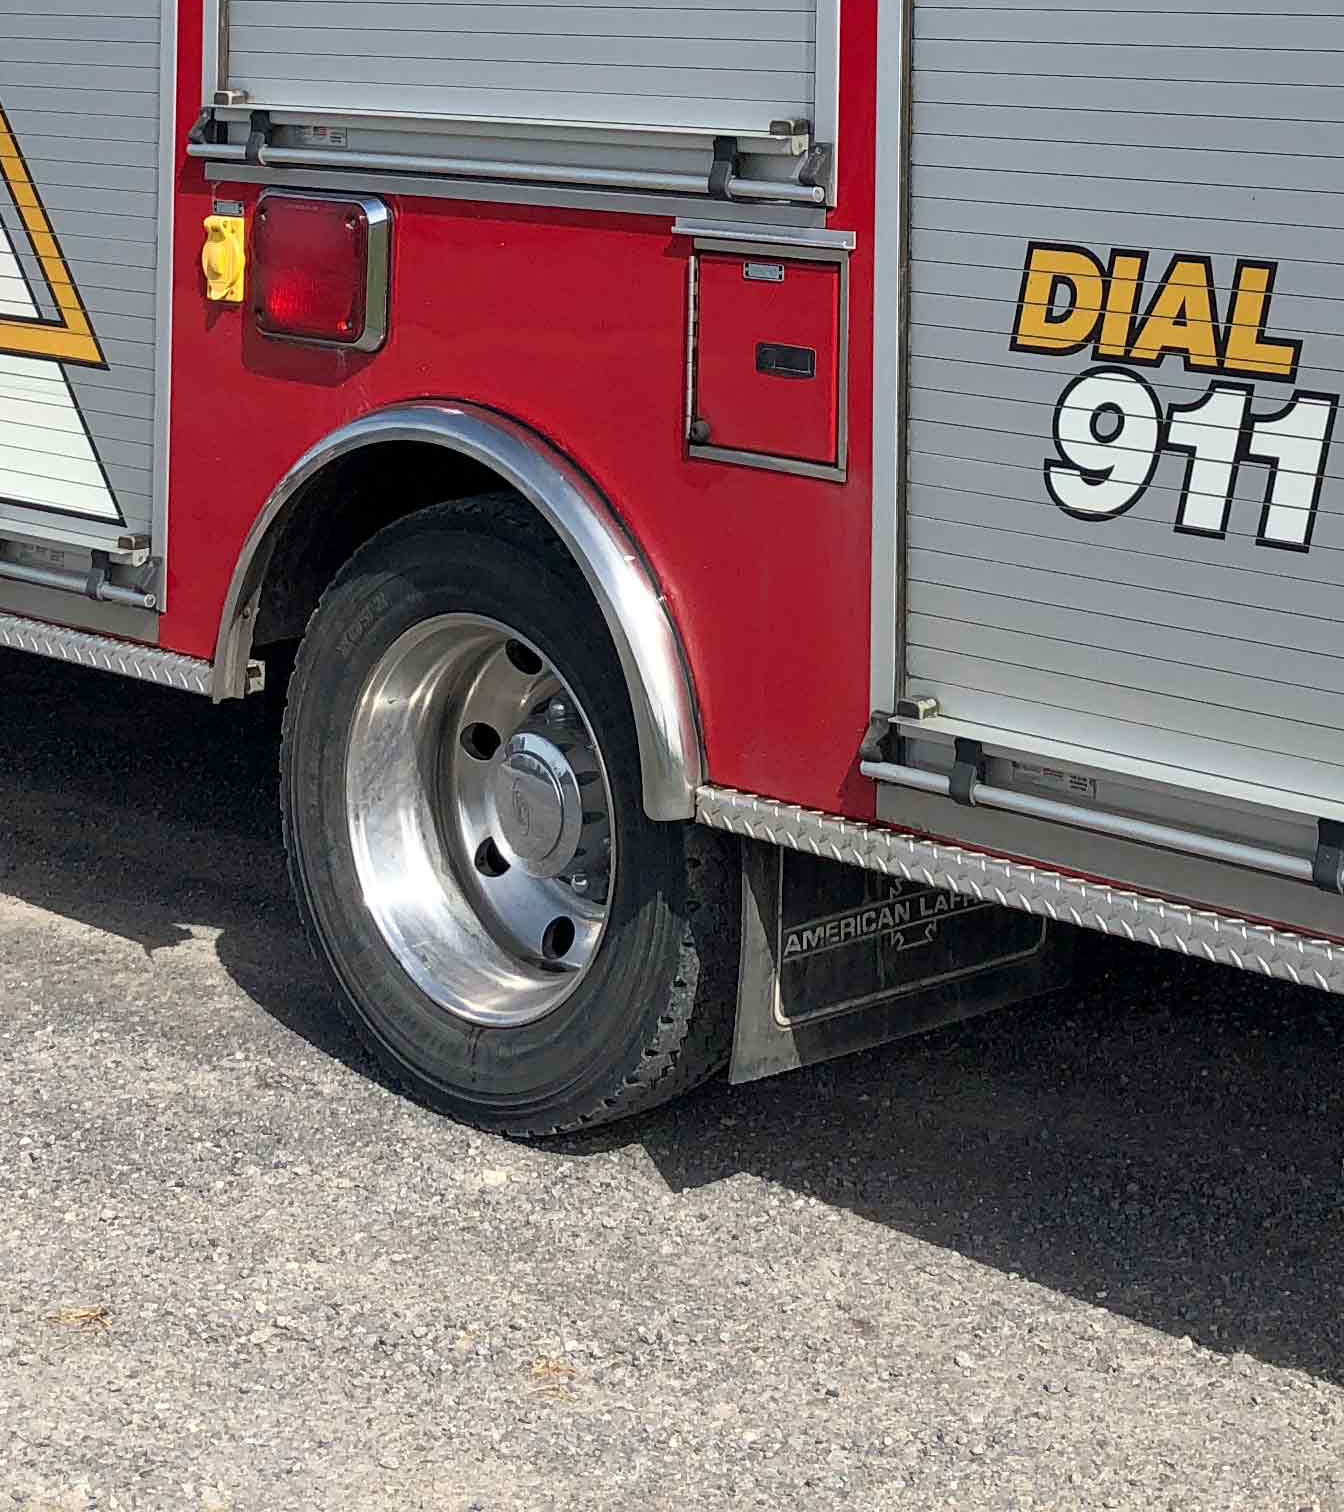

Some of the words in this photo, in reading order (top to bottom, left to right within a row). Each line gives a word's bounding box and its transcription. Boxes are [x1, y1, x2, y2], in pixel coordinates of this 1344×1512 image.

[1009, 240, 1303, 383] DIAL
[1043, 364, 1341, 553] 911
[783, 900, 910, 956] AMERICAN
